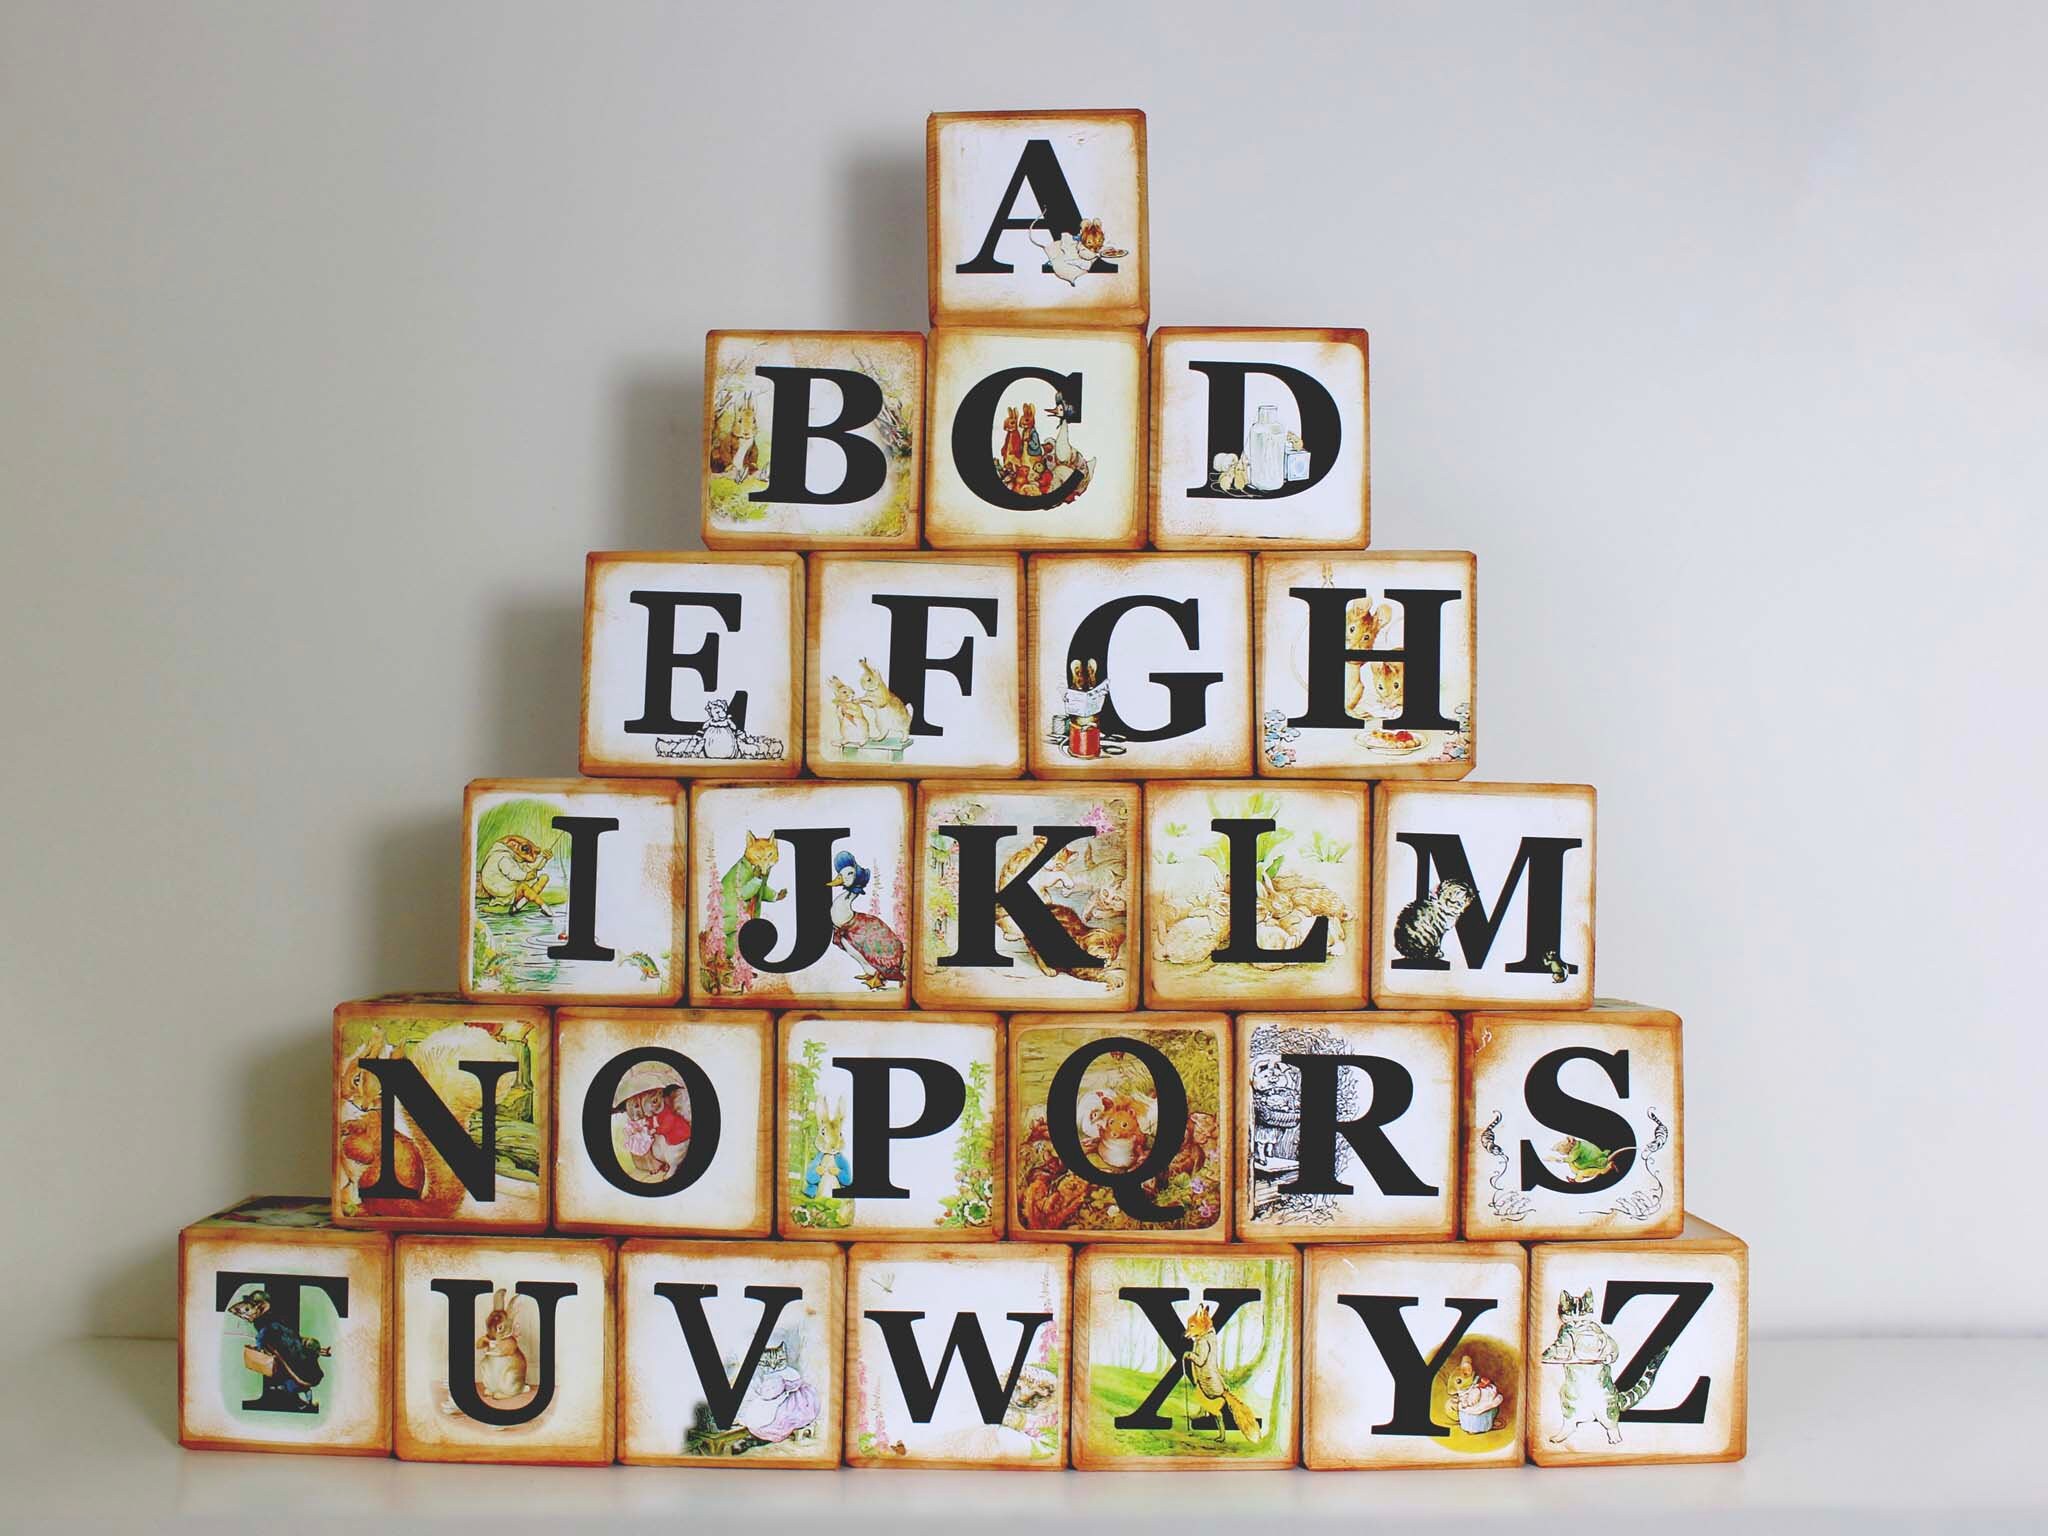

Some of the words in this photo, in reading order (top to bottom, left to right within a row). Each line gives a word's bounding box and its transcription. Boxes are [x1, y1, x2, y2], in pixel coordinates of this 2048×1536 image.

[956, 139, 1119, 274] A
[748, 366, 887, 505] B
[951, 366, 1084, 511] C
[1186, 360, 1341, 500] D
[624, 590, 748, 736] E
[871, 594, 999, 737] F
[1066, 595, 1223, 743] G
[1287, 587, 1462, 732] H
[547, 816, 619, 962] I
[738, 827, 850, 974] J
[938, 825, 1105, 970] K
[1211, 818, 1329, 963] L
[1391, 832, 1582, 974] M
[358, 1058, 518, 1202] N
[582, 1046, 721, 1198] O
[832, 1057, 966, 1199] P
[1046, 1037, 1188, 1223] Q
[1278, 1053, 1439, 1197] R
[1521, 1046, 1637, 1194] S
[215, 1271, 349, 1412] T
[430, 1279, 578, 1426] U
[654, 1282, 803, 1433] V
[864, 1311, 1053, 1425] W
[1116, 1287, 1261, 1430] X
[1337, 1295, 1498, 1437] Y
[1601, 1280, 1713, 1424] Z
